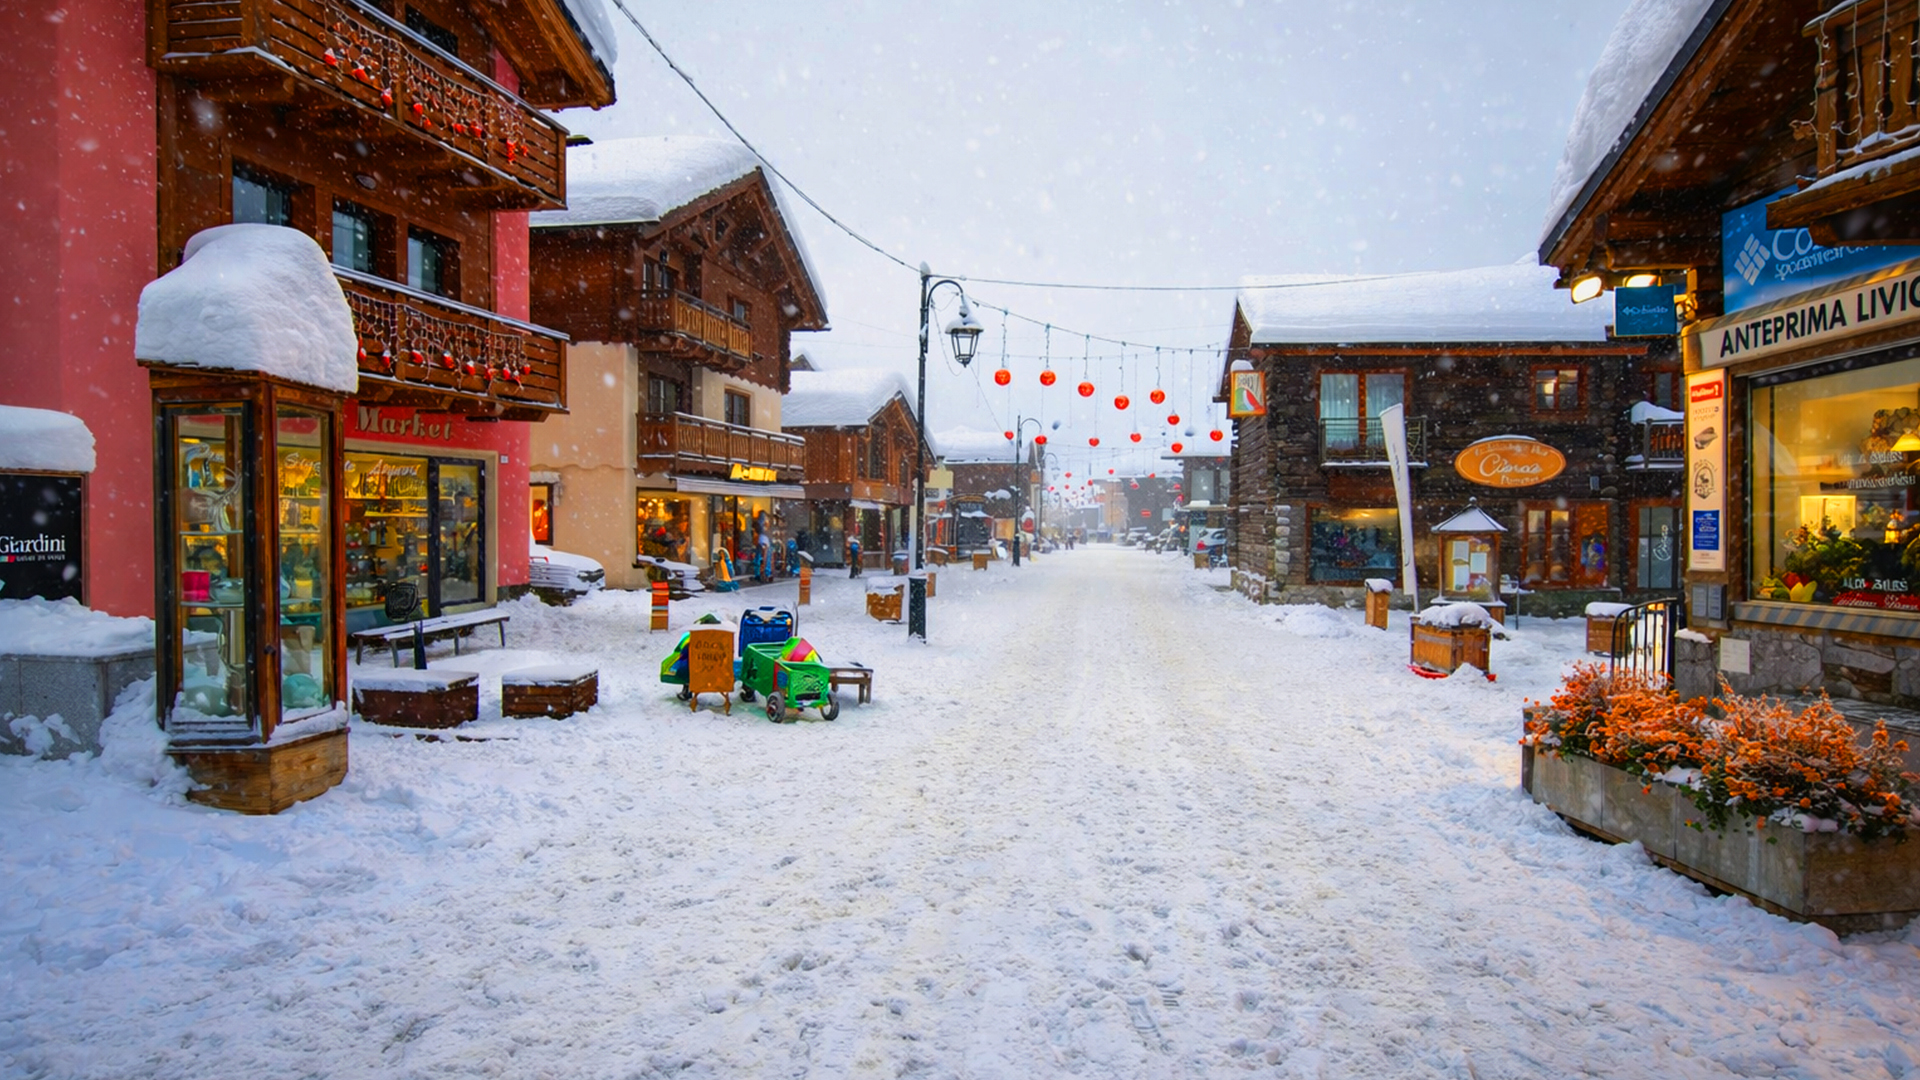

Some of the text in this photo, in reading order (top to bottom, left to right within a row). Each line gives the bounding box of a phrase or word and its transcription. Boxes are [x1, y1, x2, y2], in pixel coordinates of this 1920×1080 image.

[1720, 299, 1847, 358] ANTEPRIMA
[355, 405, 452, 440] Market
[0, 533, 66, 554] Giardini
